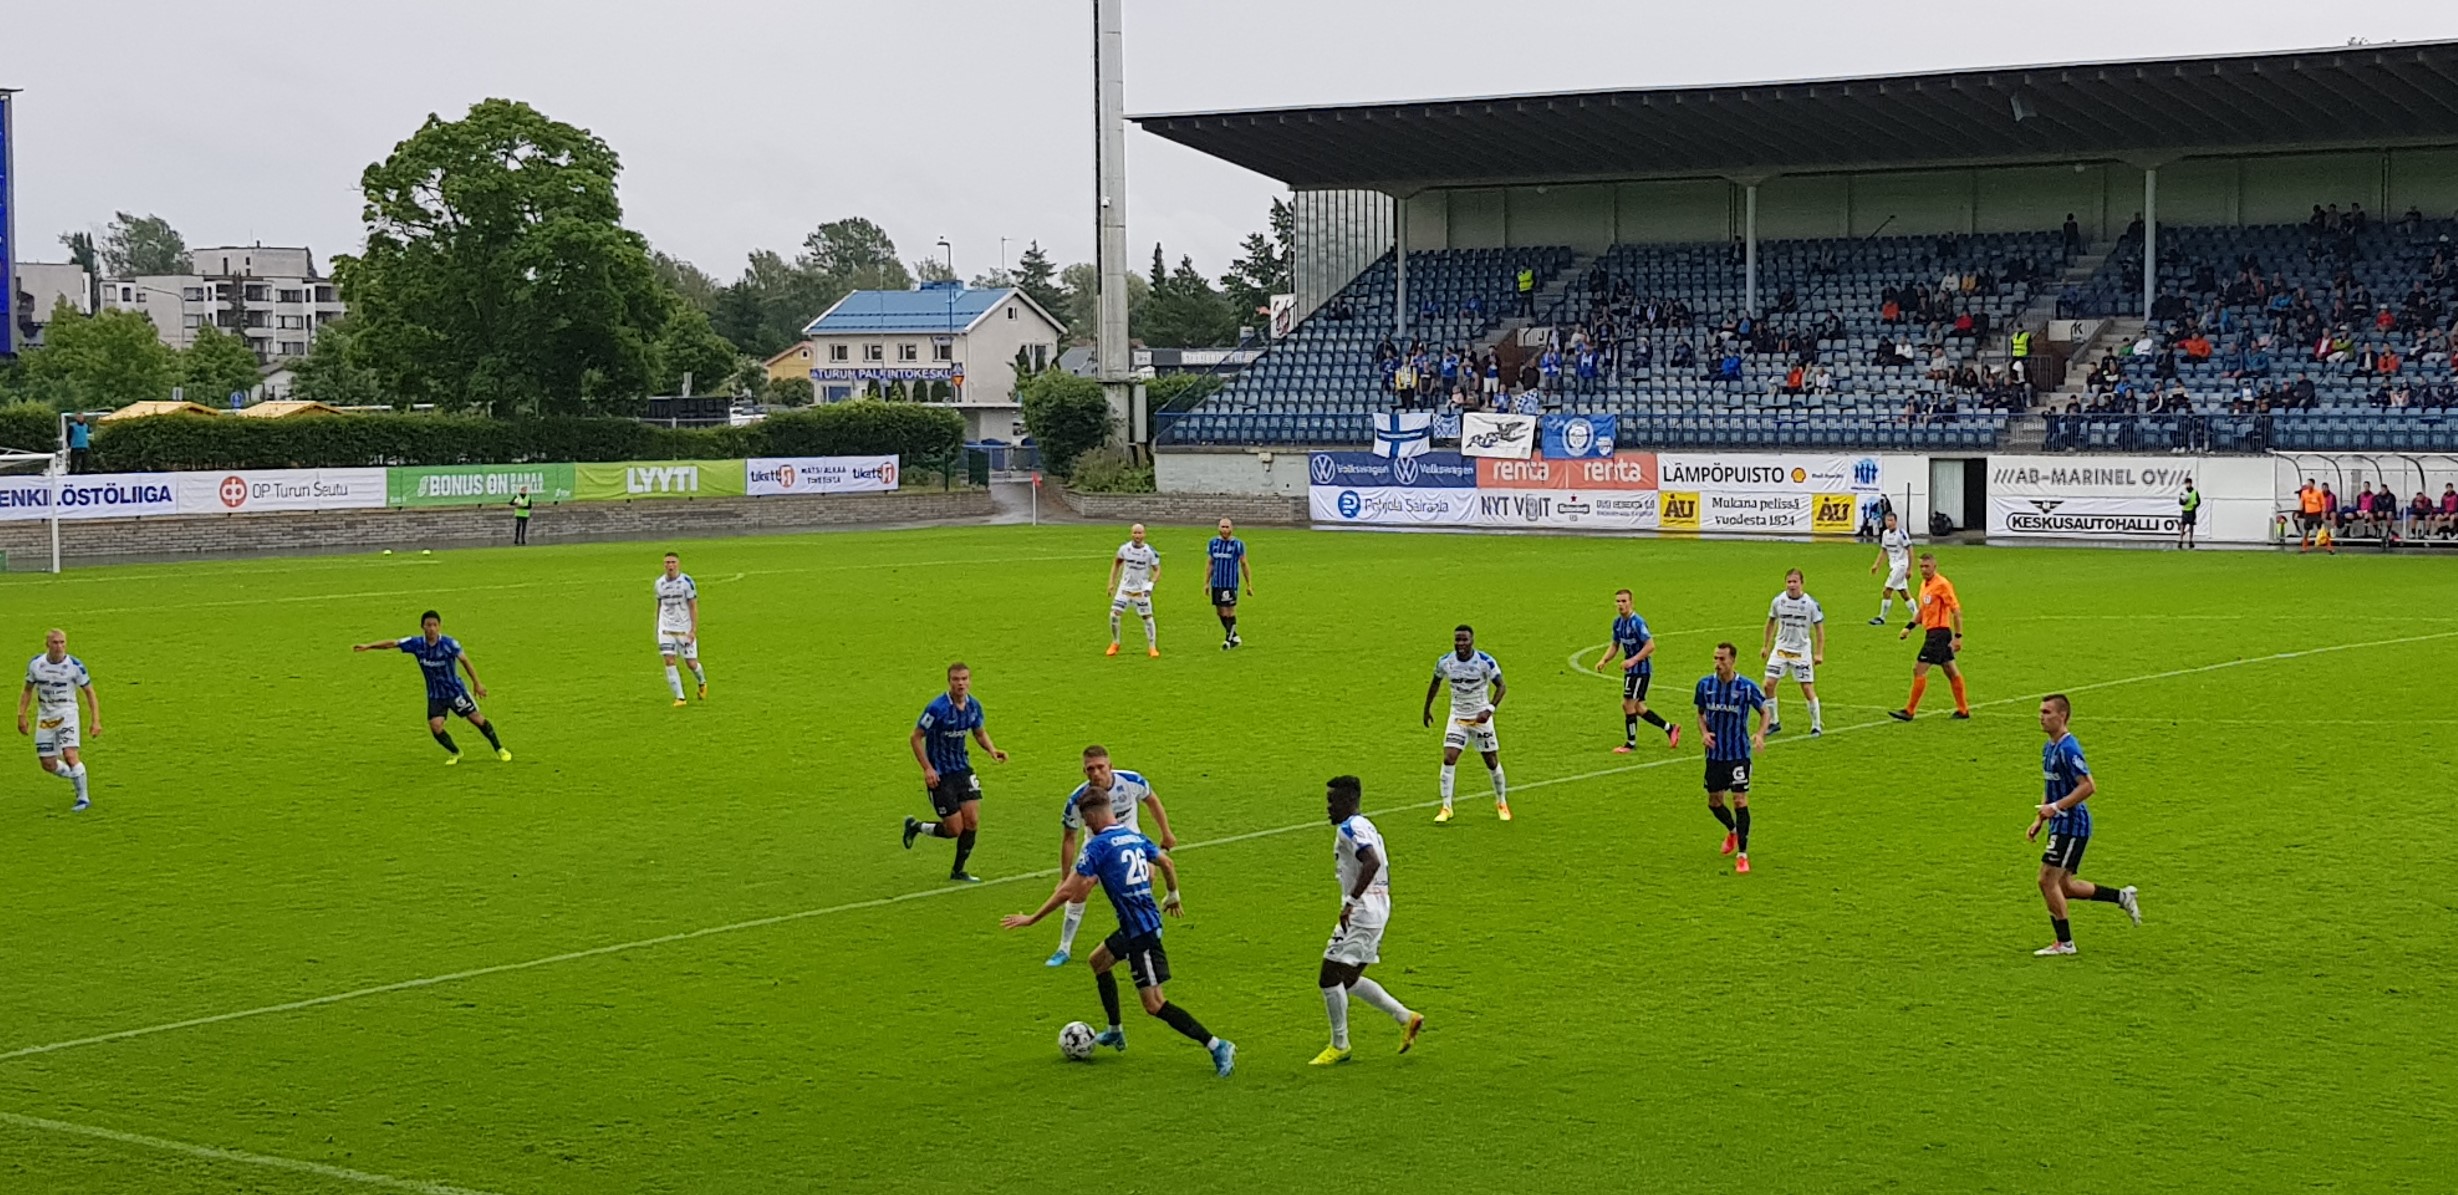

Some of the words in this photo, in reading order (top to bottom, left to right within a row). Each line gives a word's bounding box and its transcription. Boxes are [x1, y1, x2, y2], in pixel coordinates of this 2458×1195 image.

[858, 368, 952, 379] PALINTOKESKU
[1336, 463, 1389, 476] Volkswagen
[1419, 463, 1474, 477] Volkswagen
[1493, 460, 1549, 481] renta
[1584, 458, 1642, 482] renta
[1663, 463, 1785, 483] LÄMPÖPUISTO
[429, 474, 484, 496] BONUS
[486, 474, 508, 495] ON
[627, 466, 698, 494] LYYTI
[252, 484, 270, 499] OP
[274, 483, 310, 498] Turun
[313, 482, 348, 497] Seutu
[1481, 496, 1509, 515] NYT
[1712, 497, 1757, 509] Mukana
[1760, 496, 1800, 512] pelissä
[1715, 514, 1766, 526] vuodesta
[1769, 514, 1795, 526] 1824
[2012, 516, 2159, 531] KESKUSAUTOHALLI
[1121, 847, 1149, 885] 26
